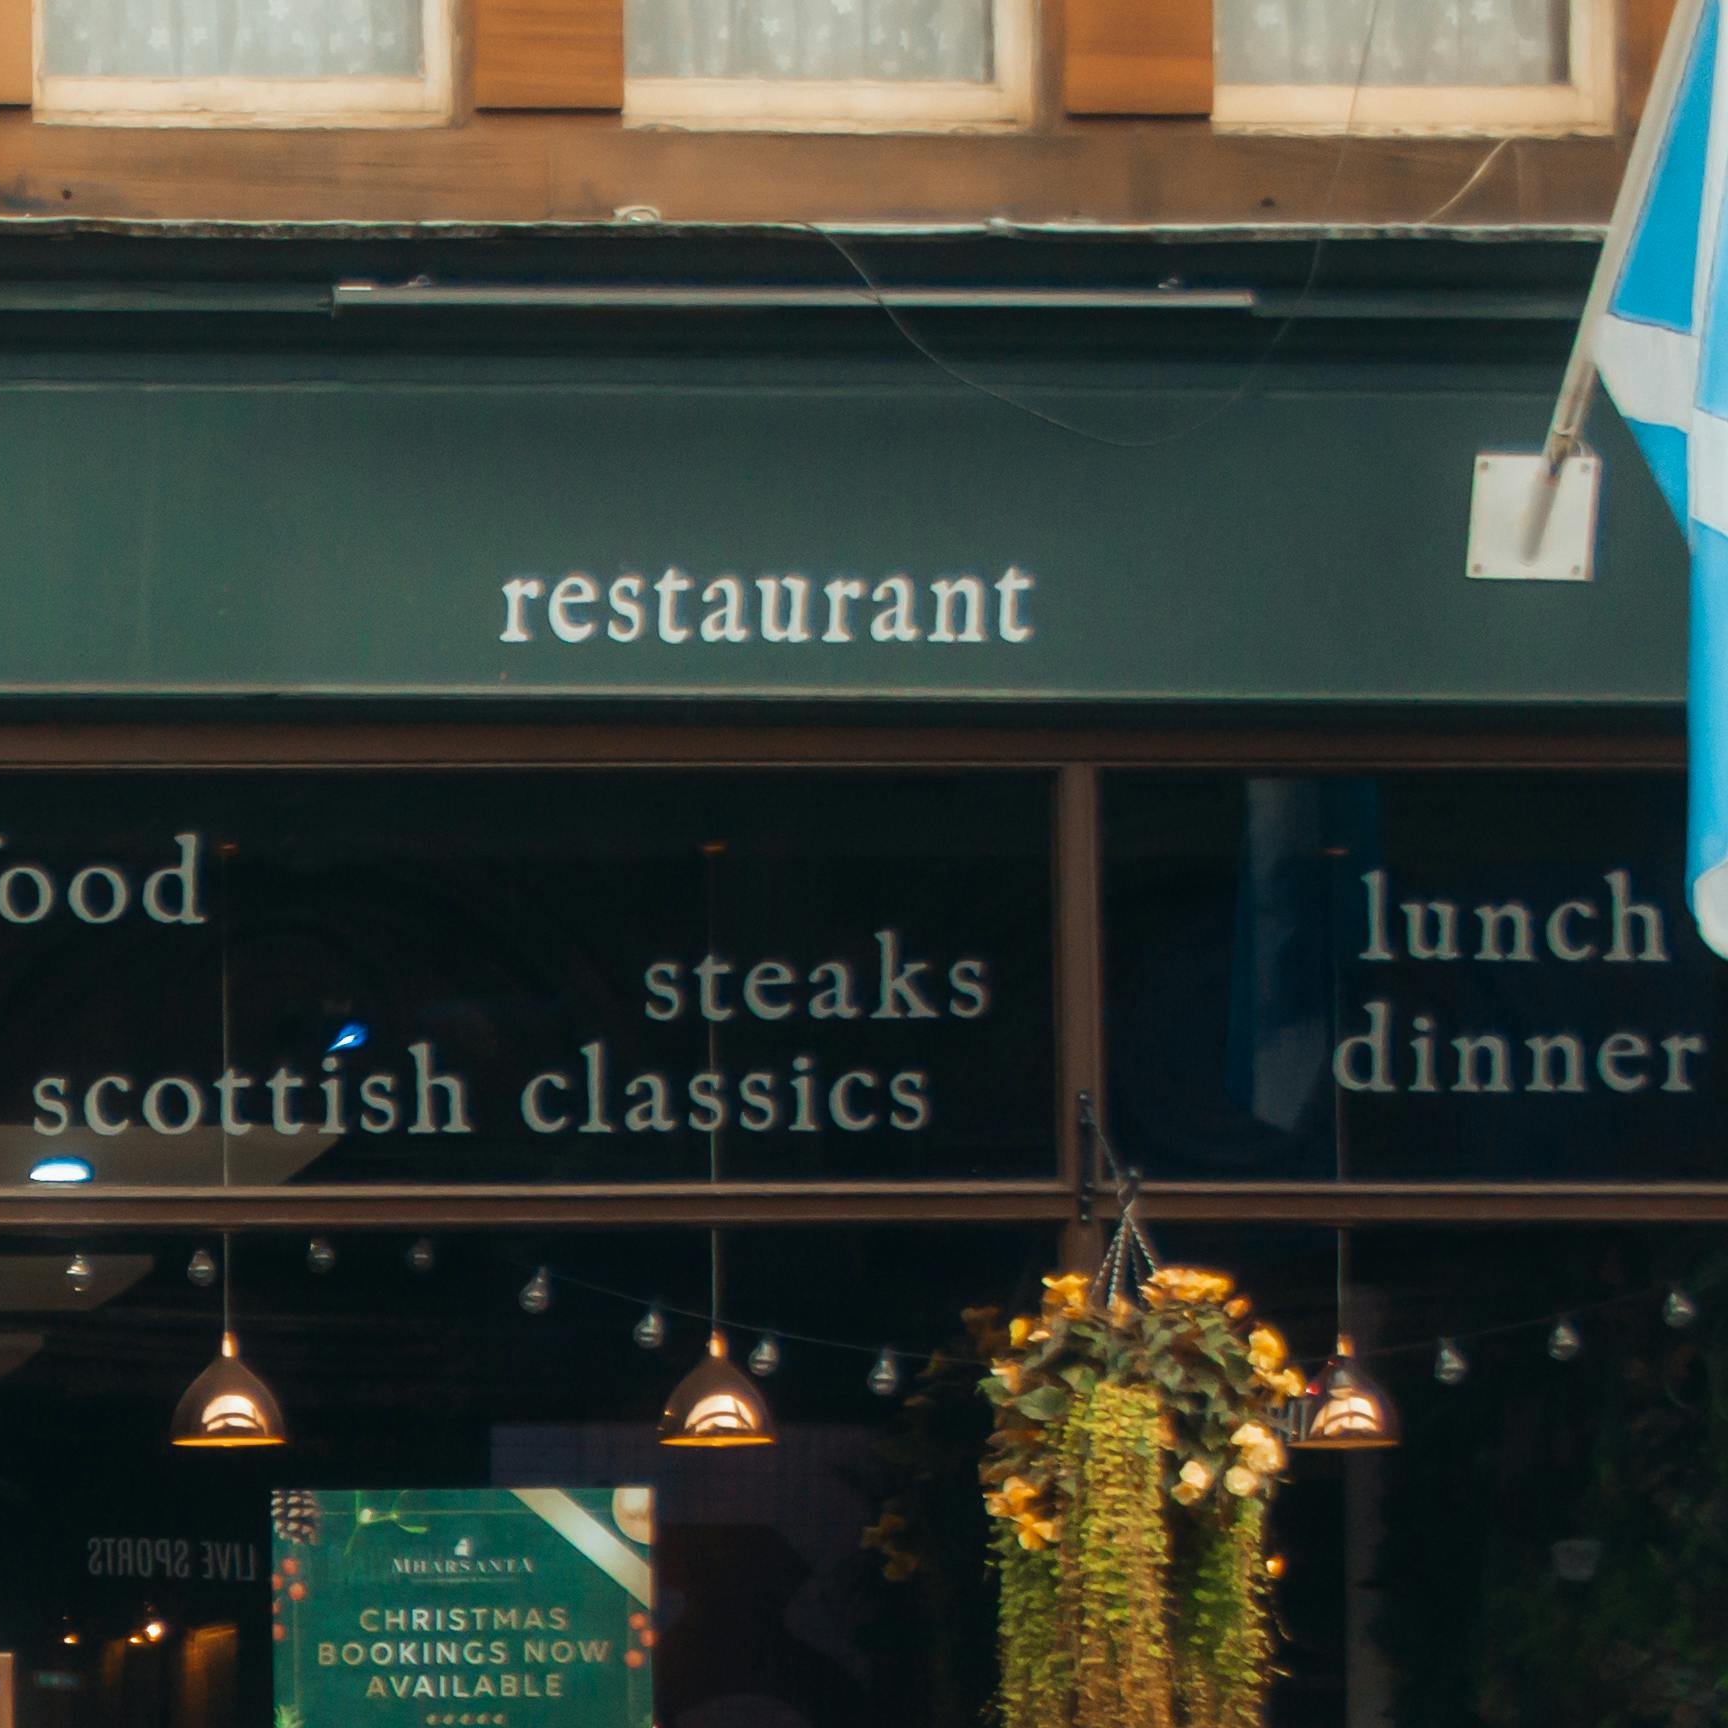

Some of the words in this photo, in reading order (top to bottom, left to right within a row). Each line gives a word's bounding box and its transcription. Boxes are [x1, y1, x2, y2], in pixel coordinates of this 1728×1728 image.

[499, 566, 1033, 645] restaurant
[1359, 869, 1669, 962] lunch
[644, 929, 988, 1022] steaks
[1332, 1000, 1704, 1093] dinner
[31, 1041, 472, 1137] scottish
[521, 1041, 929, 1134] classics
[391, 1557, 533, 1575] MHARSANTA
[318, 1641, 509, 1666] BOOKINGS
[523, 1640, 610, 1664] NOW
[360, 1608, 569, 1633] CHRISTMAS
[365, 1674, 563, 1699] AVAILABLE
